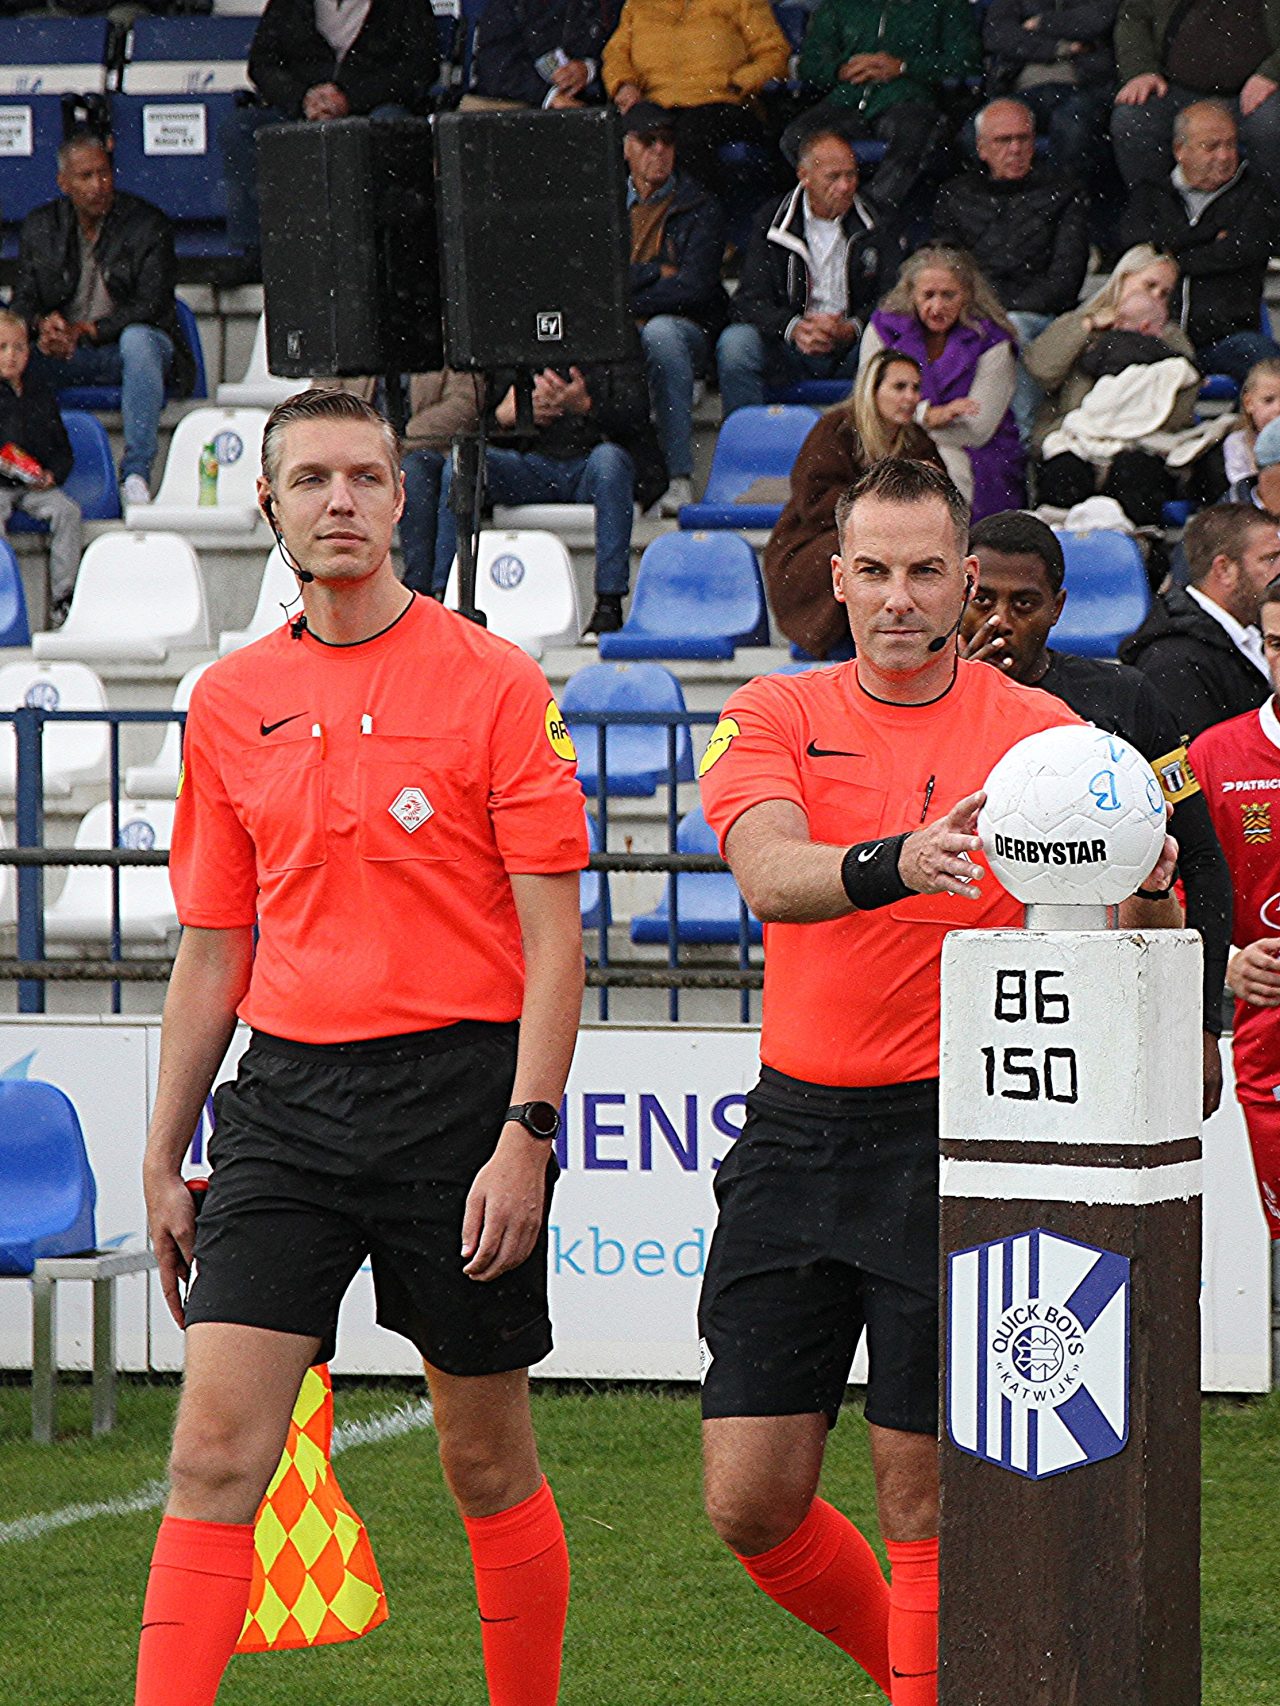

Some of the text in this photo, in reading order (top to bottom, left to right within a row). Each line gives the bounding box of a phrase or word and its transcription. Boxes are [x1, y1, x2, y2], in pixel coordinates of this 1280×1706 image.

[995, 833, 1107, 866] DERBYSTAR
[994, 970, 1070, 1025] 86
[981, 1045, 1079, 1105] 150
[992, 1304, 1084, 1356] QUICK BOYS
